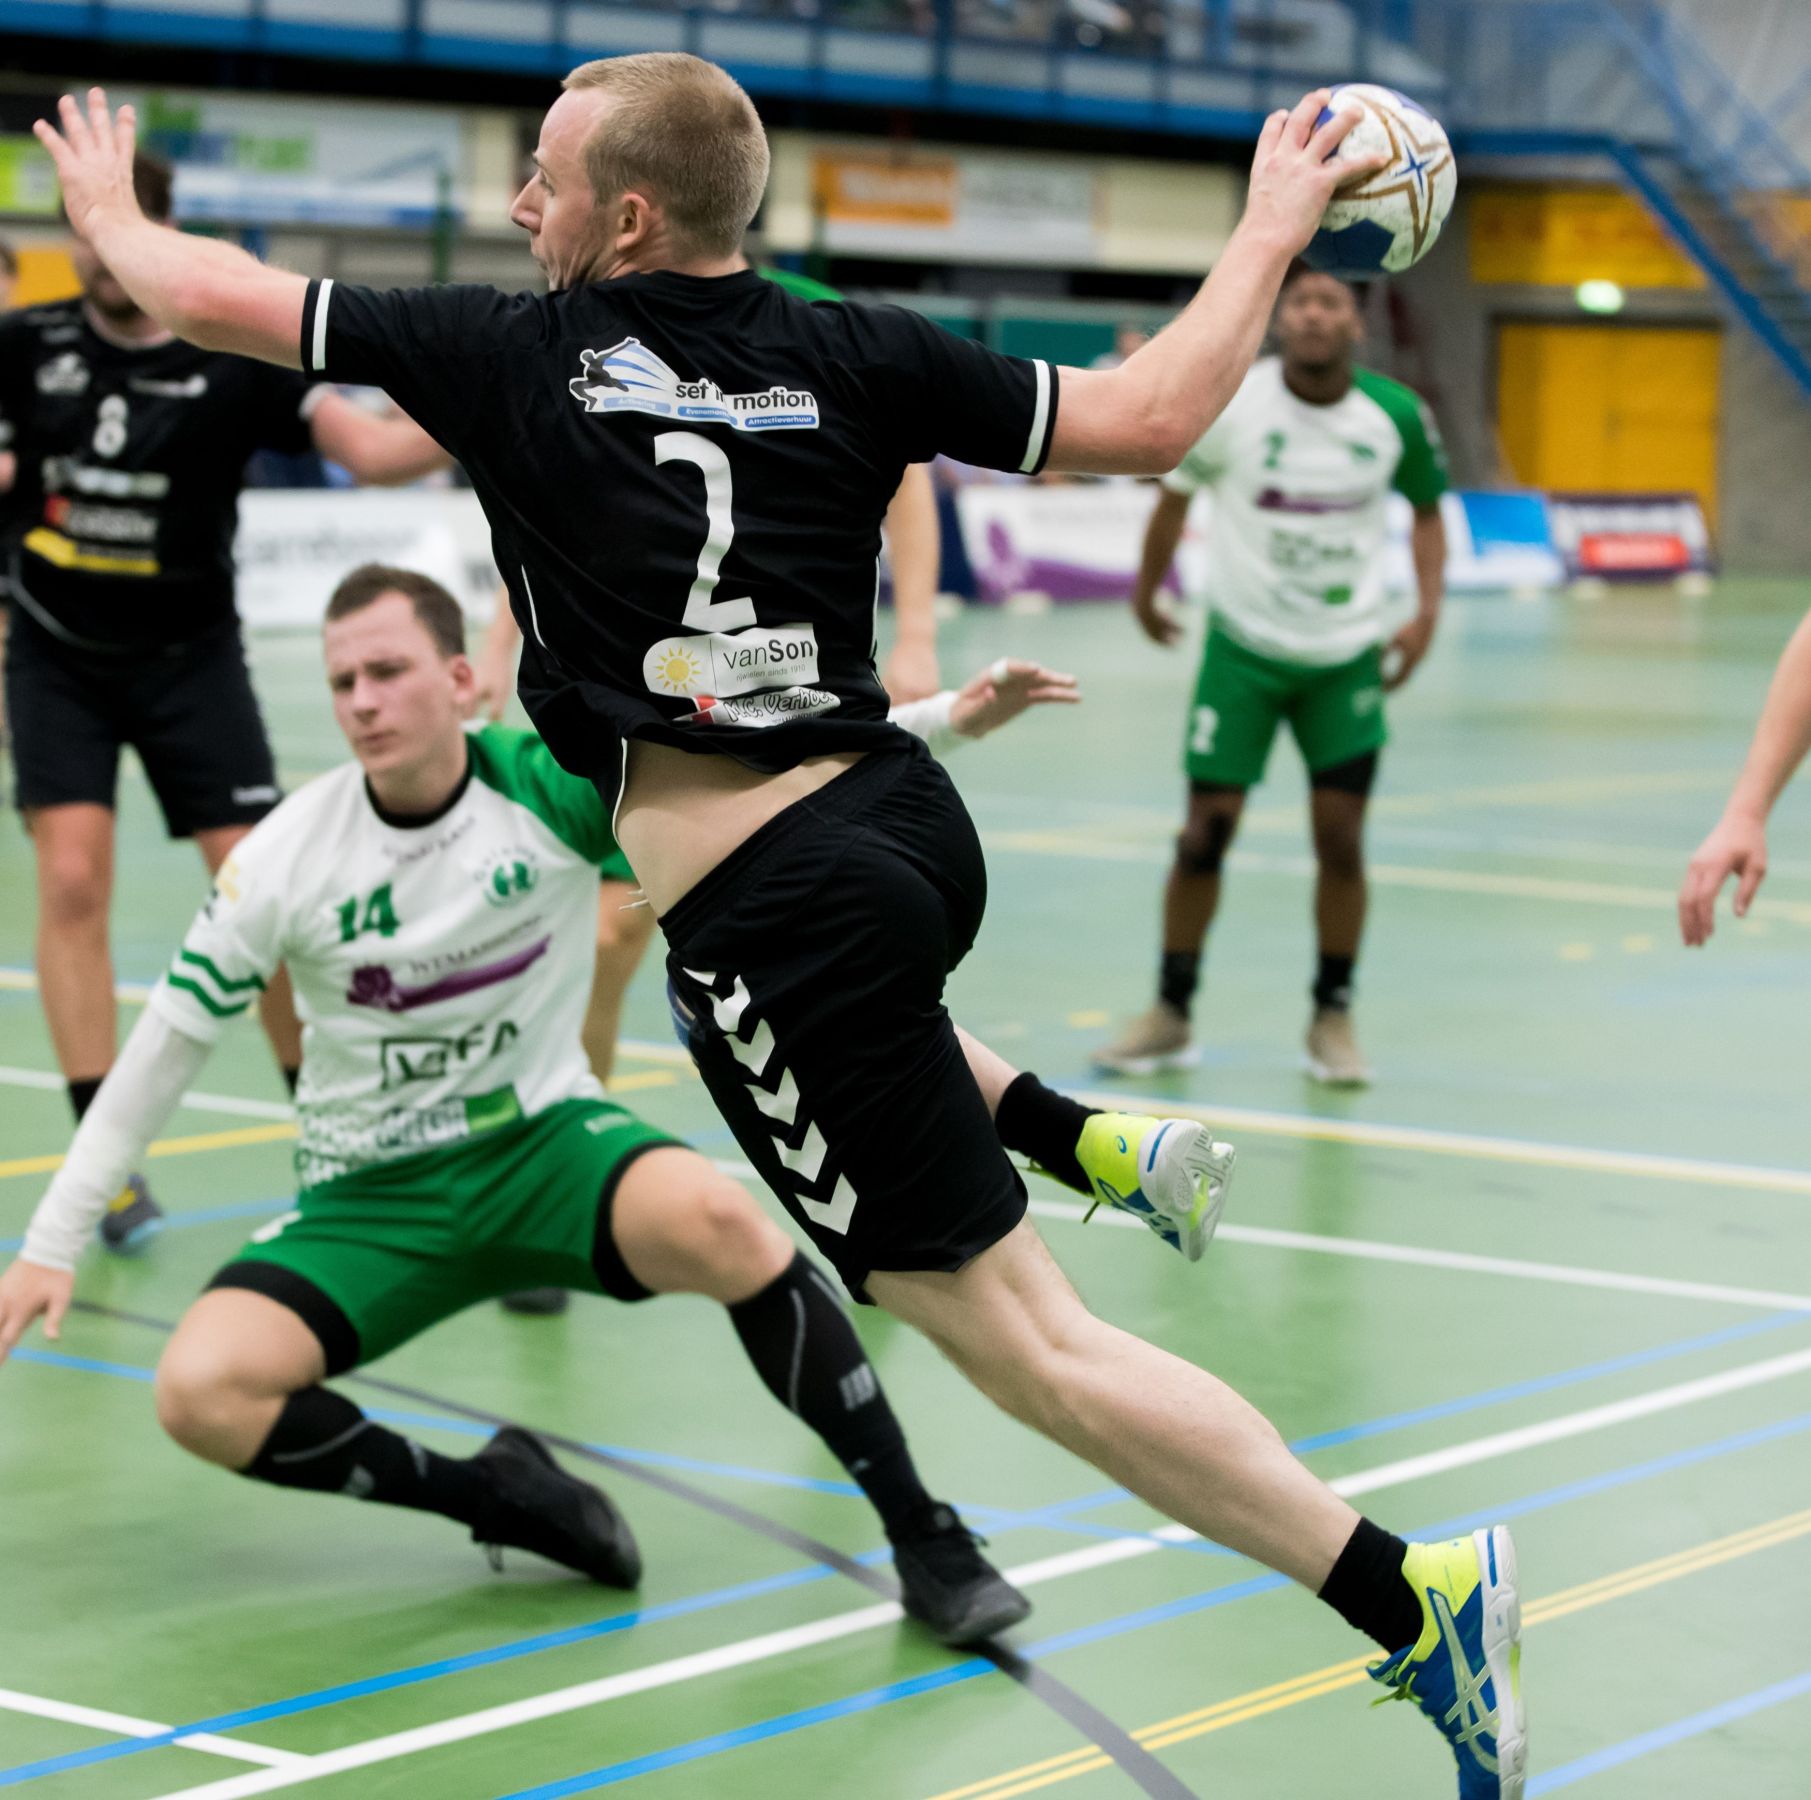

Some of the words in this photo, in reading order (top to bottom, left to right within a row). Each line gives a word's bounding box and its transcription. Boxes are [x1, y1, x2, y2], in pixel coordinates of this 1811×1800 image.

[676, 382, 709, 399] set
[734, 389, 814, 410] motion
[93, 393, 129, 459] 8
[653, 431, 757, 632] 2
[723, 638, 813, 669] vanSon
[723, 698, 763, 723] M.C.
[336, 880, 401, 944] 14
